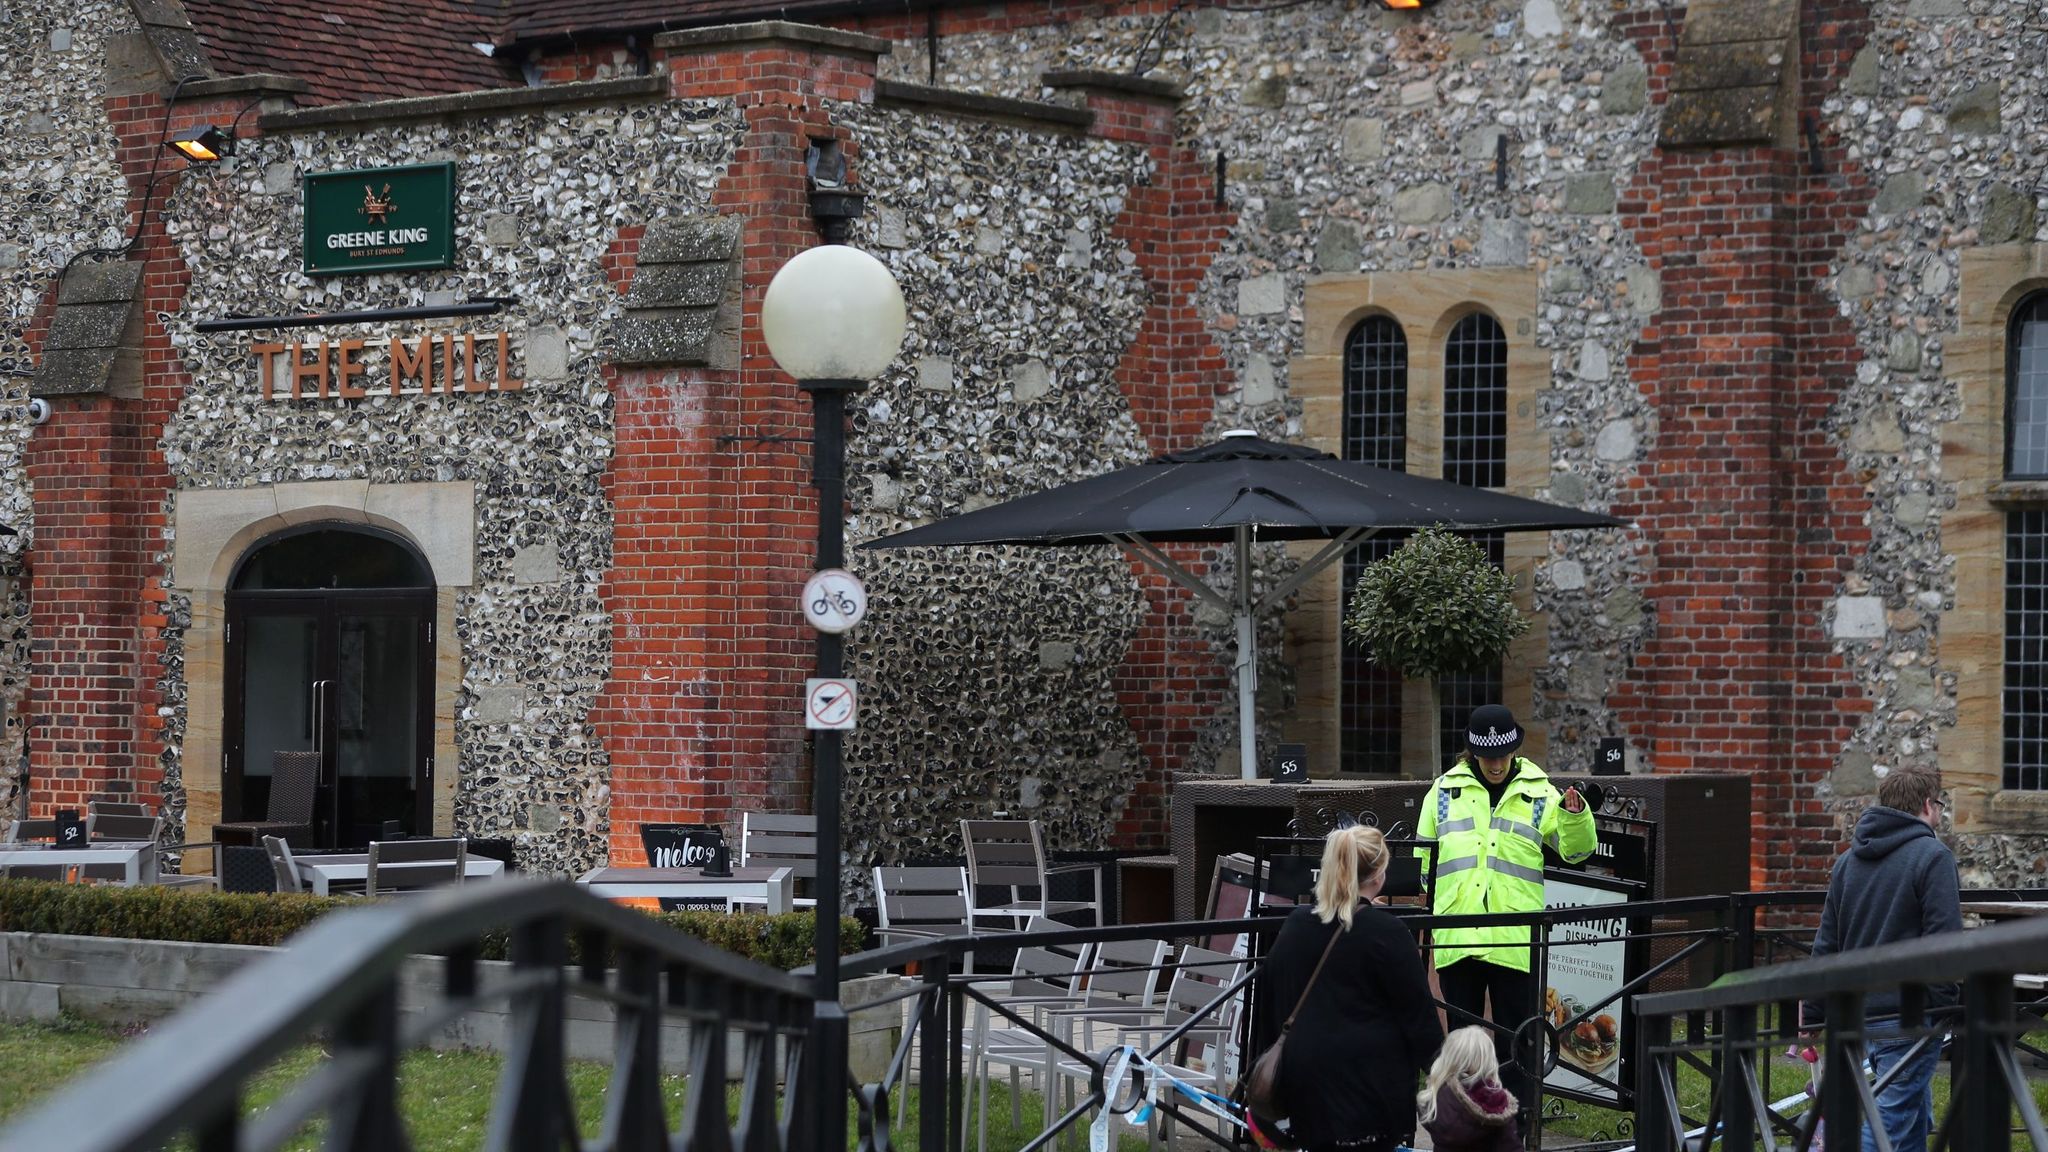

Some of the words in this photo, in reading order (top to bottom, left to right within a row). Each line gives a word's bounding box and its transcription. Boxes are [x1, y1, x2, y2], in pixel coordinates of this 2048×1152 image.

[327, 231, 386, 249] GREENE
[388, 227, 428, 245] KING
[375, 247, 404, 256] EDMUNDS
[251, 339, 367, 400] THE
[390, 332, 525, 397] MILL
[1606, 748, 1621, 762] 56
[1281, 760, 1298, 775] 55
[64, 826, 79, 840] 52
[654, 837, 705, 868] Welco
[1595, 842, 1615, 858] ILL
[676, 903, 686, 911] TO
[687, 903, 711, 911] ORDER
[1565, 930, 1598, 947] DISHES
[1548, 953, 1559, 961] THE
[1561, 955, 1589, 967] PERFECT
[1591, 961, 1614, 972] DISHES
[1548, 962, 1557, 970] TO
[1558, 964, 1578, 975] ENJOY
[1580, 969, 1613, 981] TOGETHER
